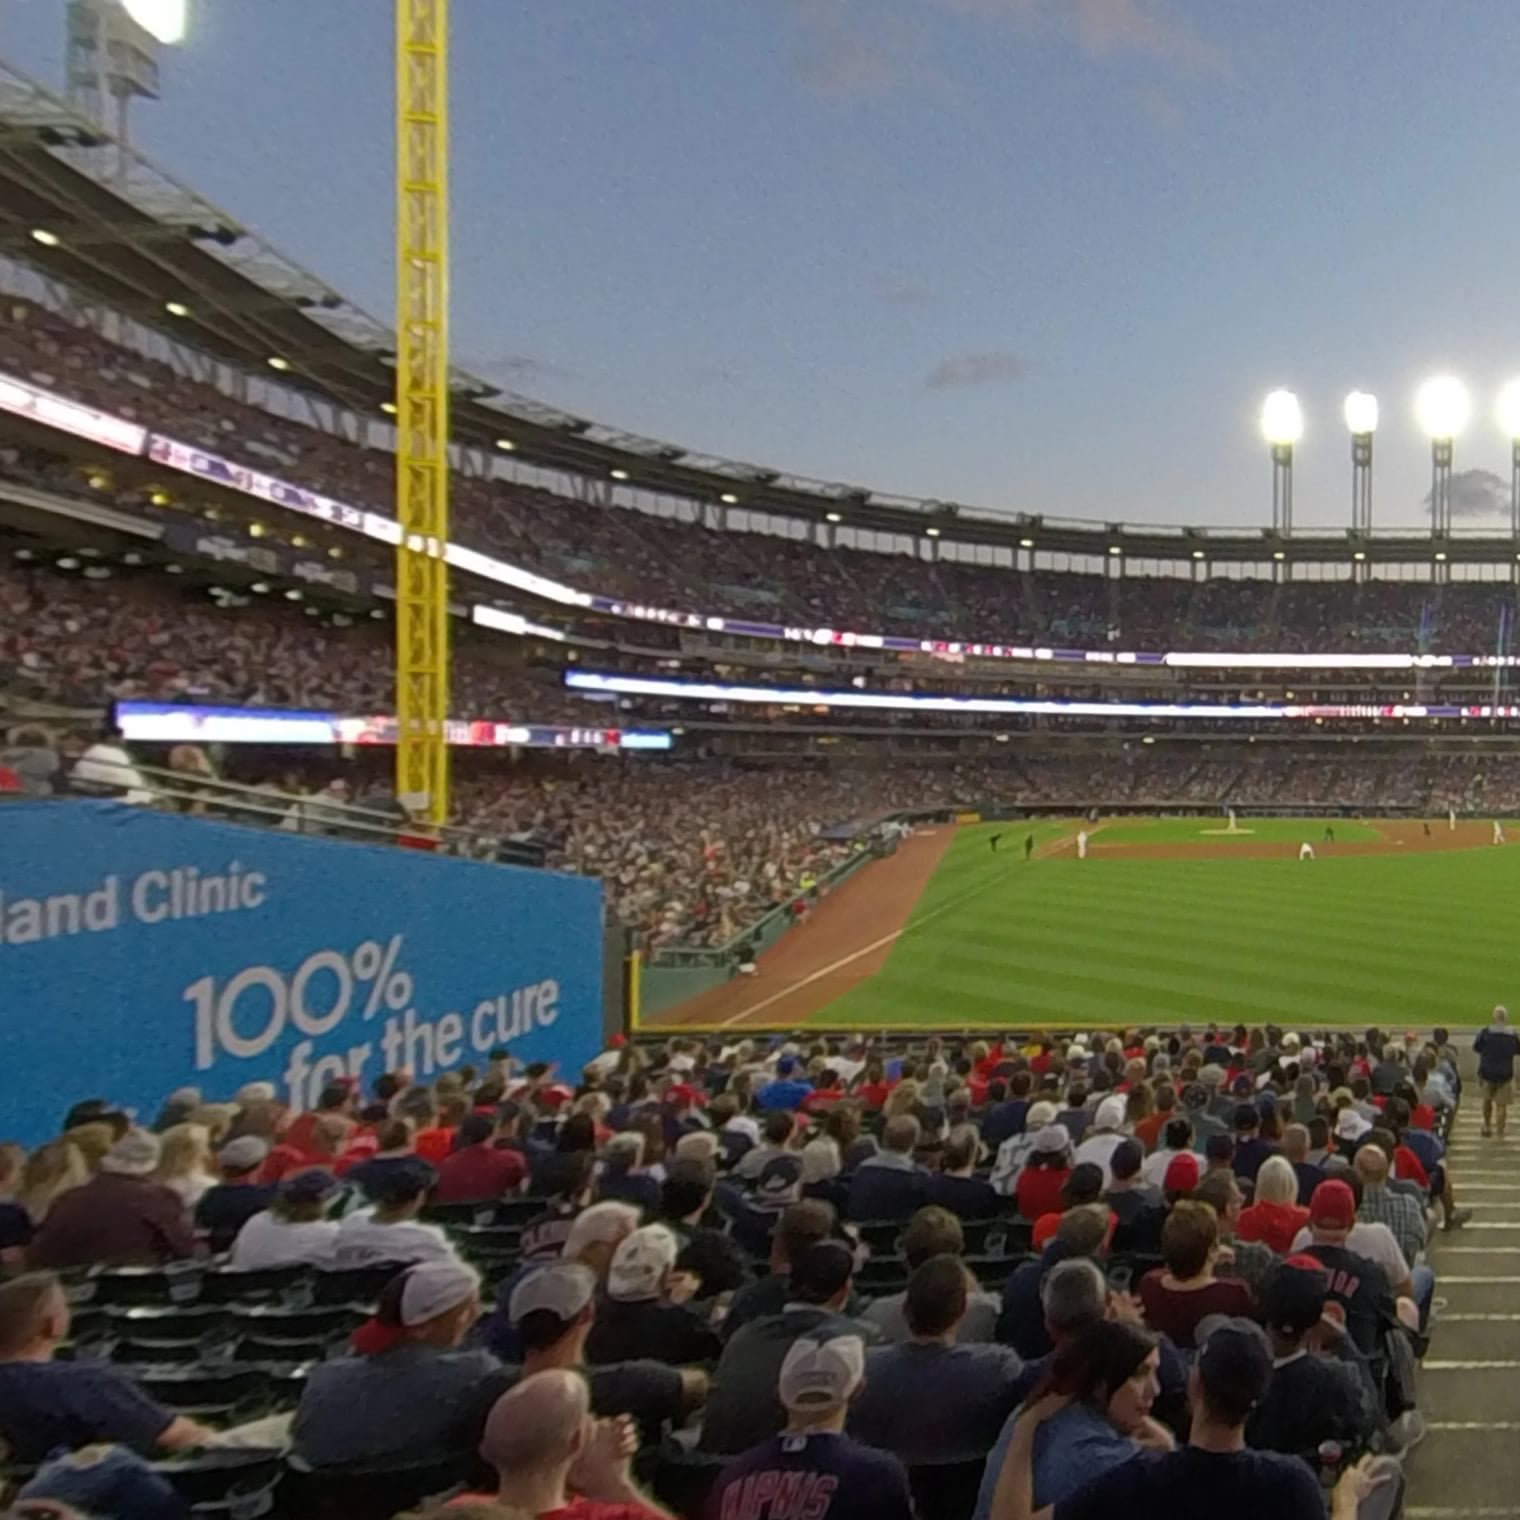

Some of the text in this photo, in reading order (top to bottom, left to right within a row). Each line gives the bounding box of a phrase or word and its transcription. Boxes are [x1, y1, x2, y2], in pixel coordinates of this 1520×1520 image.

[133, 860, 267, 924] Clinic
[184, 934, 413, 1070] 100%
[285, 978, 559, 1111] for the cure
